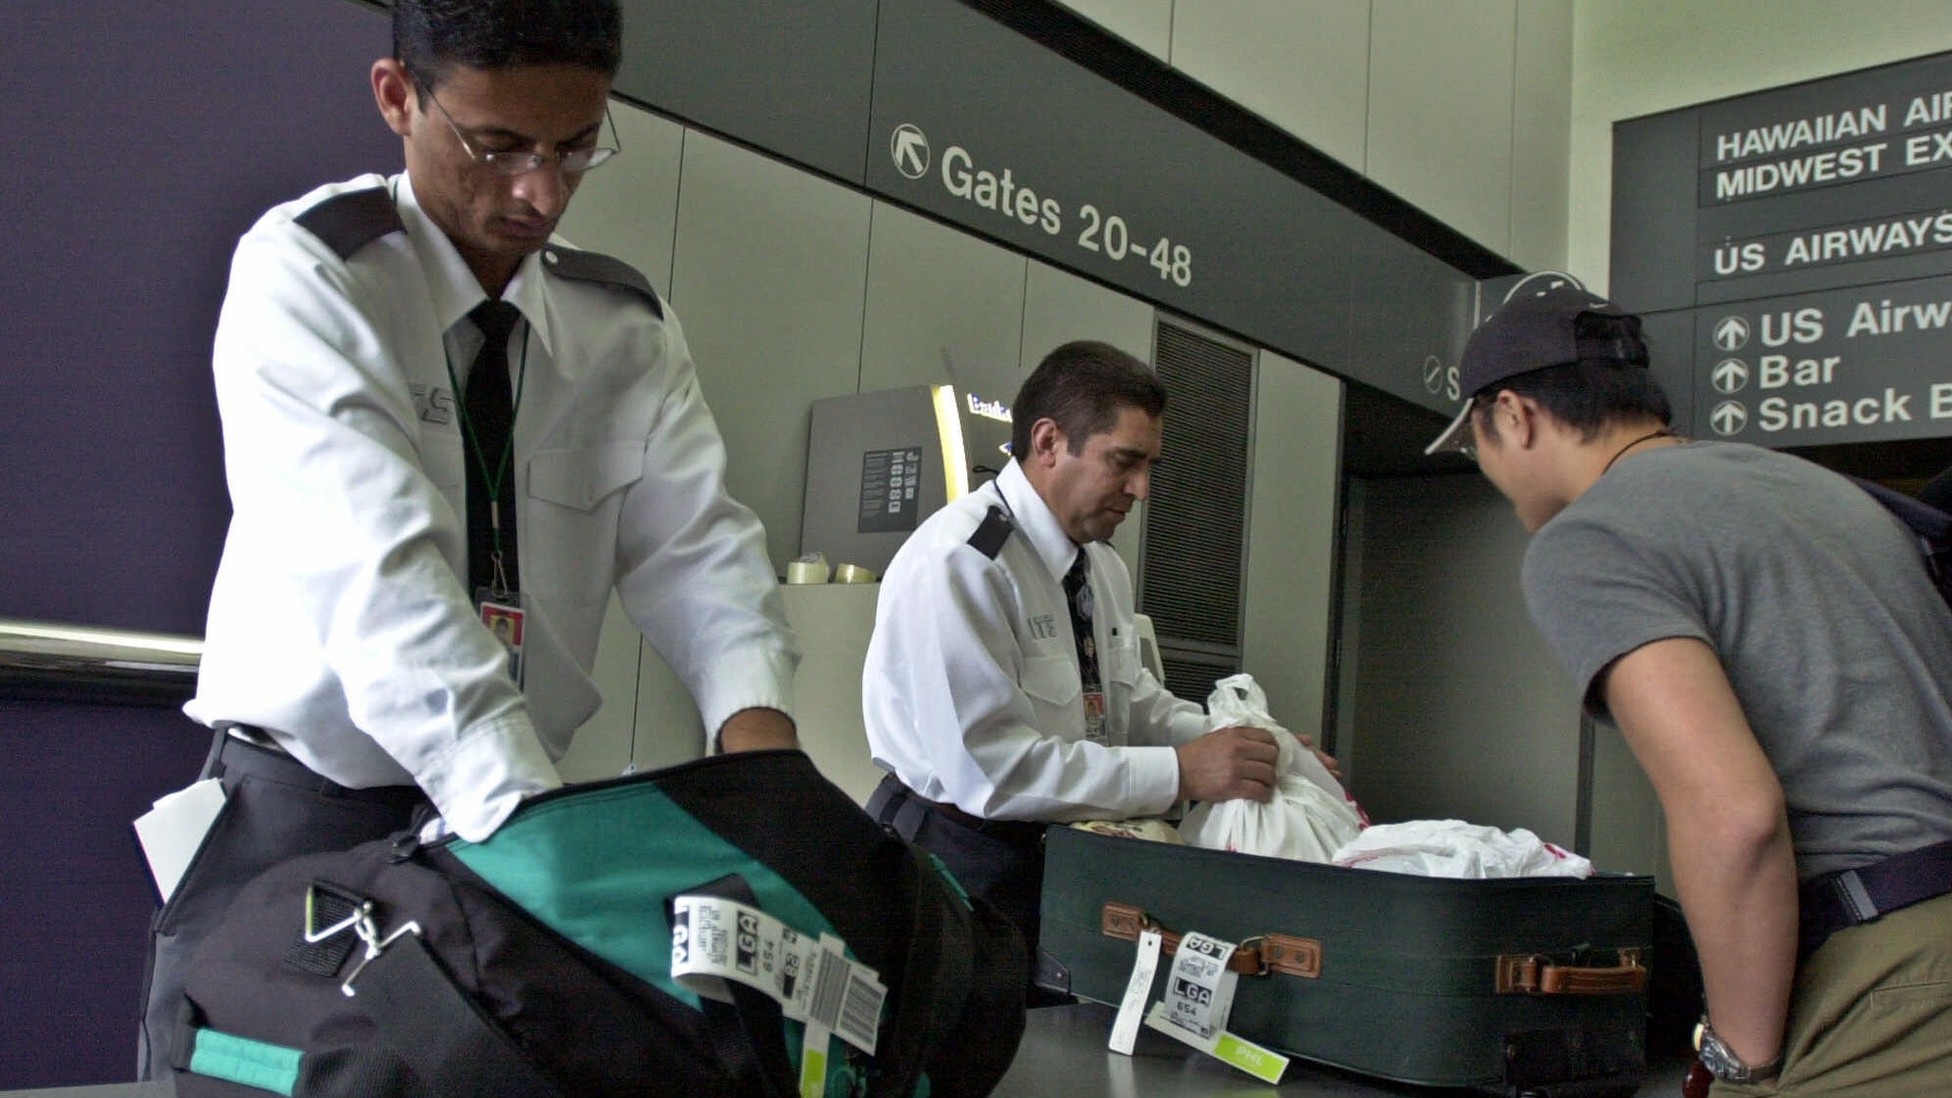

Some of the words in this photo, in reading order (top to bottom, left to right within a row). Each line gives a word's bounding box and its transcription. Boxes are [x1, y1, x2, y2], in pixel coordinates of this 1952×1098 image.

[1716, 104, 1887, 162] HAWAIIAN
[1716, 143, 1888, 199] MIDWEST
[1906, 131, 1952, 166] EX
[941, 145, 1061, 235] Gates
[1078, 204, 1192, 288] 20-48
[1714, 243, 1766, 276] US
[1784, 213, 1952, 266] AIRWAYS
[1760, 307, 1823, 347] US
[1845, 299, 1952, 338] Airw
[1759, 354, 1841, 389] Bar
[1758, 387, 1913, 432] Snack
[737, 911, 759, 976] LGA
[1174, 977, 1213, 1007] LGA
